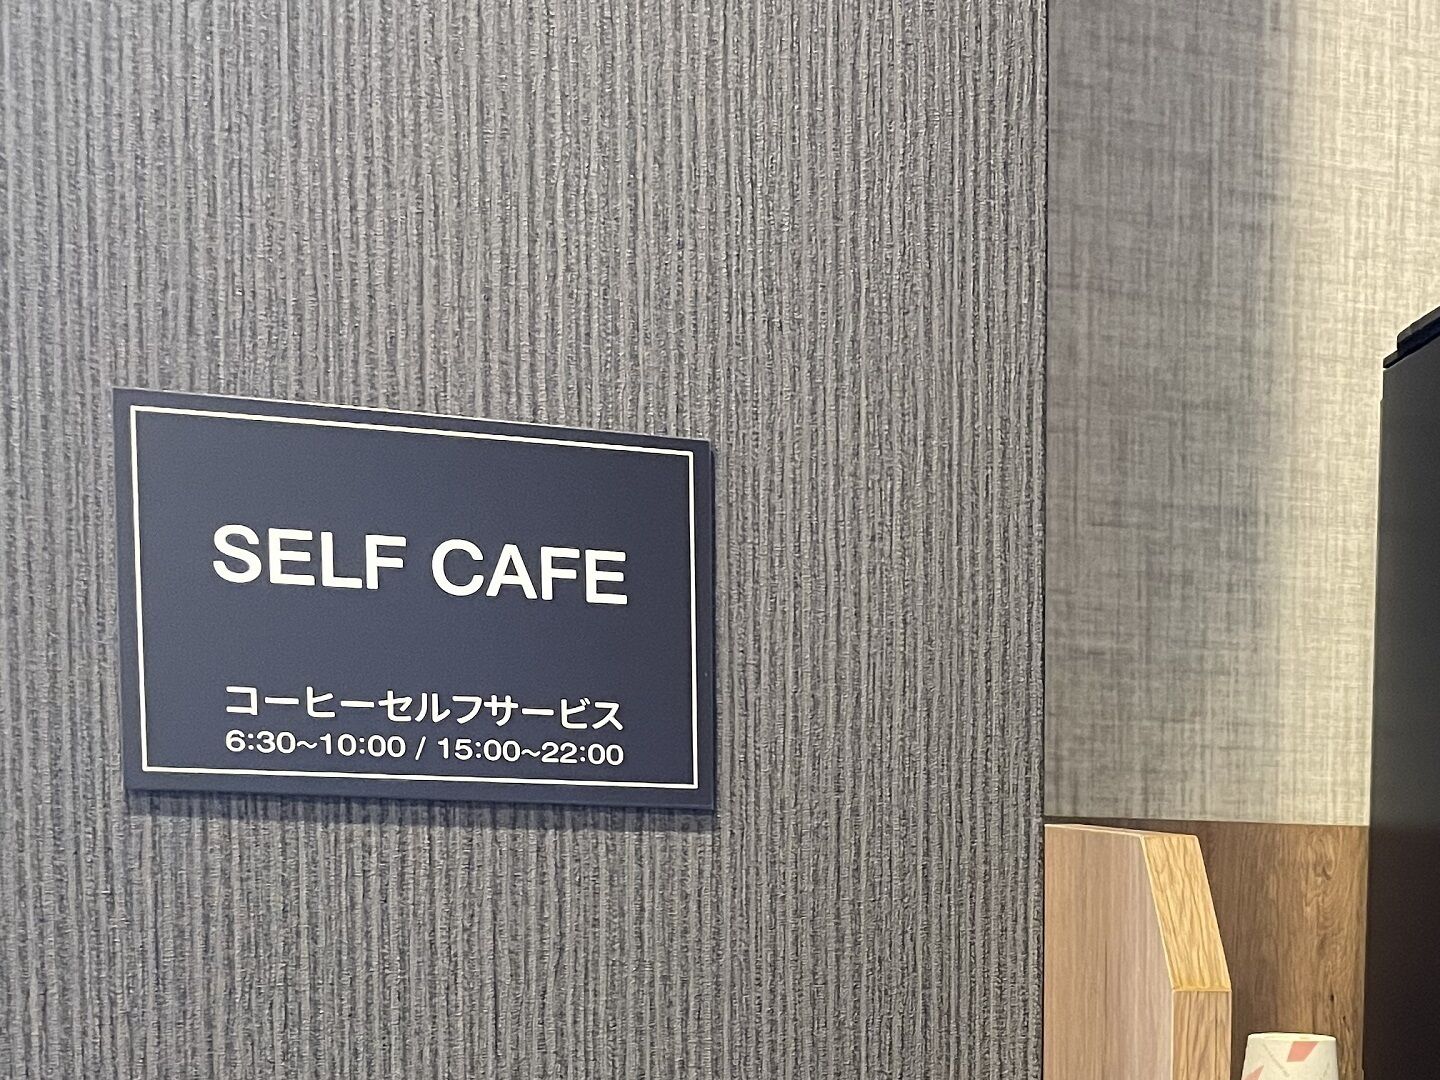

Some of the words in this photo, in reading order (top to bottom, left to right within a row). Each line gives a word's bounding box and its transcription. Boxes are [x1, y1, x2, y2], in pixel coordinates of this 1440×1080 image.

[213, 524, 407, 590] SELF
[431, 538, 629, 606] CAFE
[225, 685, 624, 731] コーヒーセルフサービス
